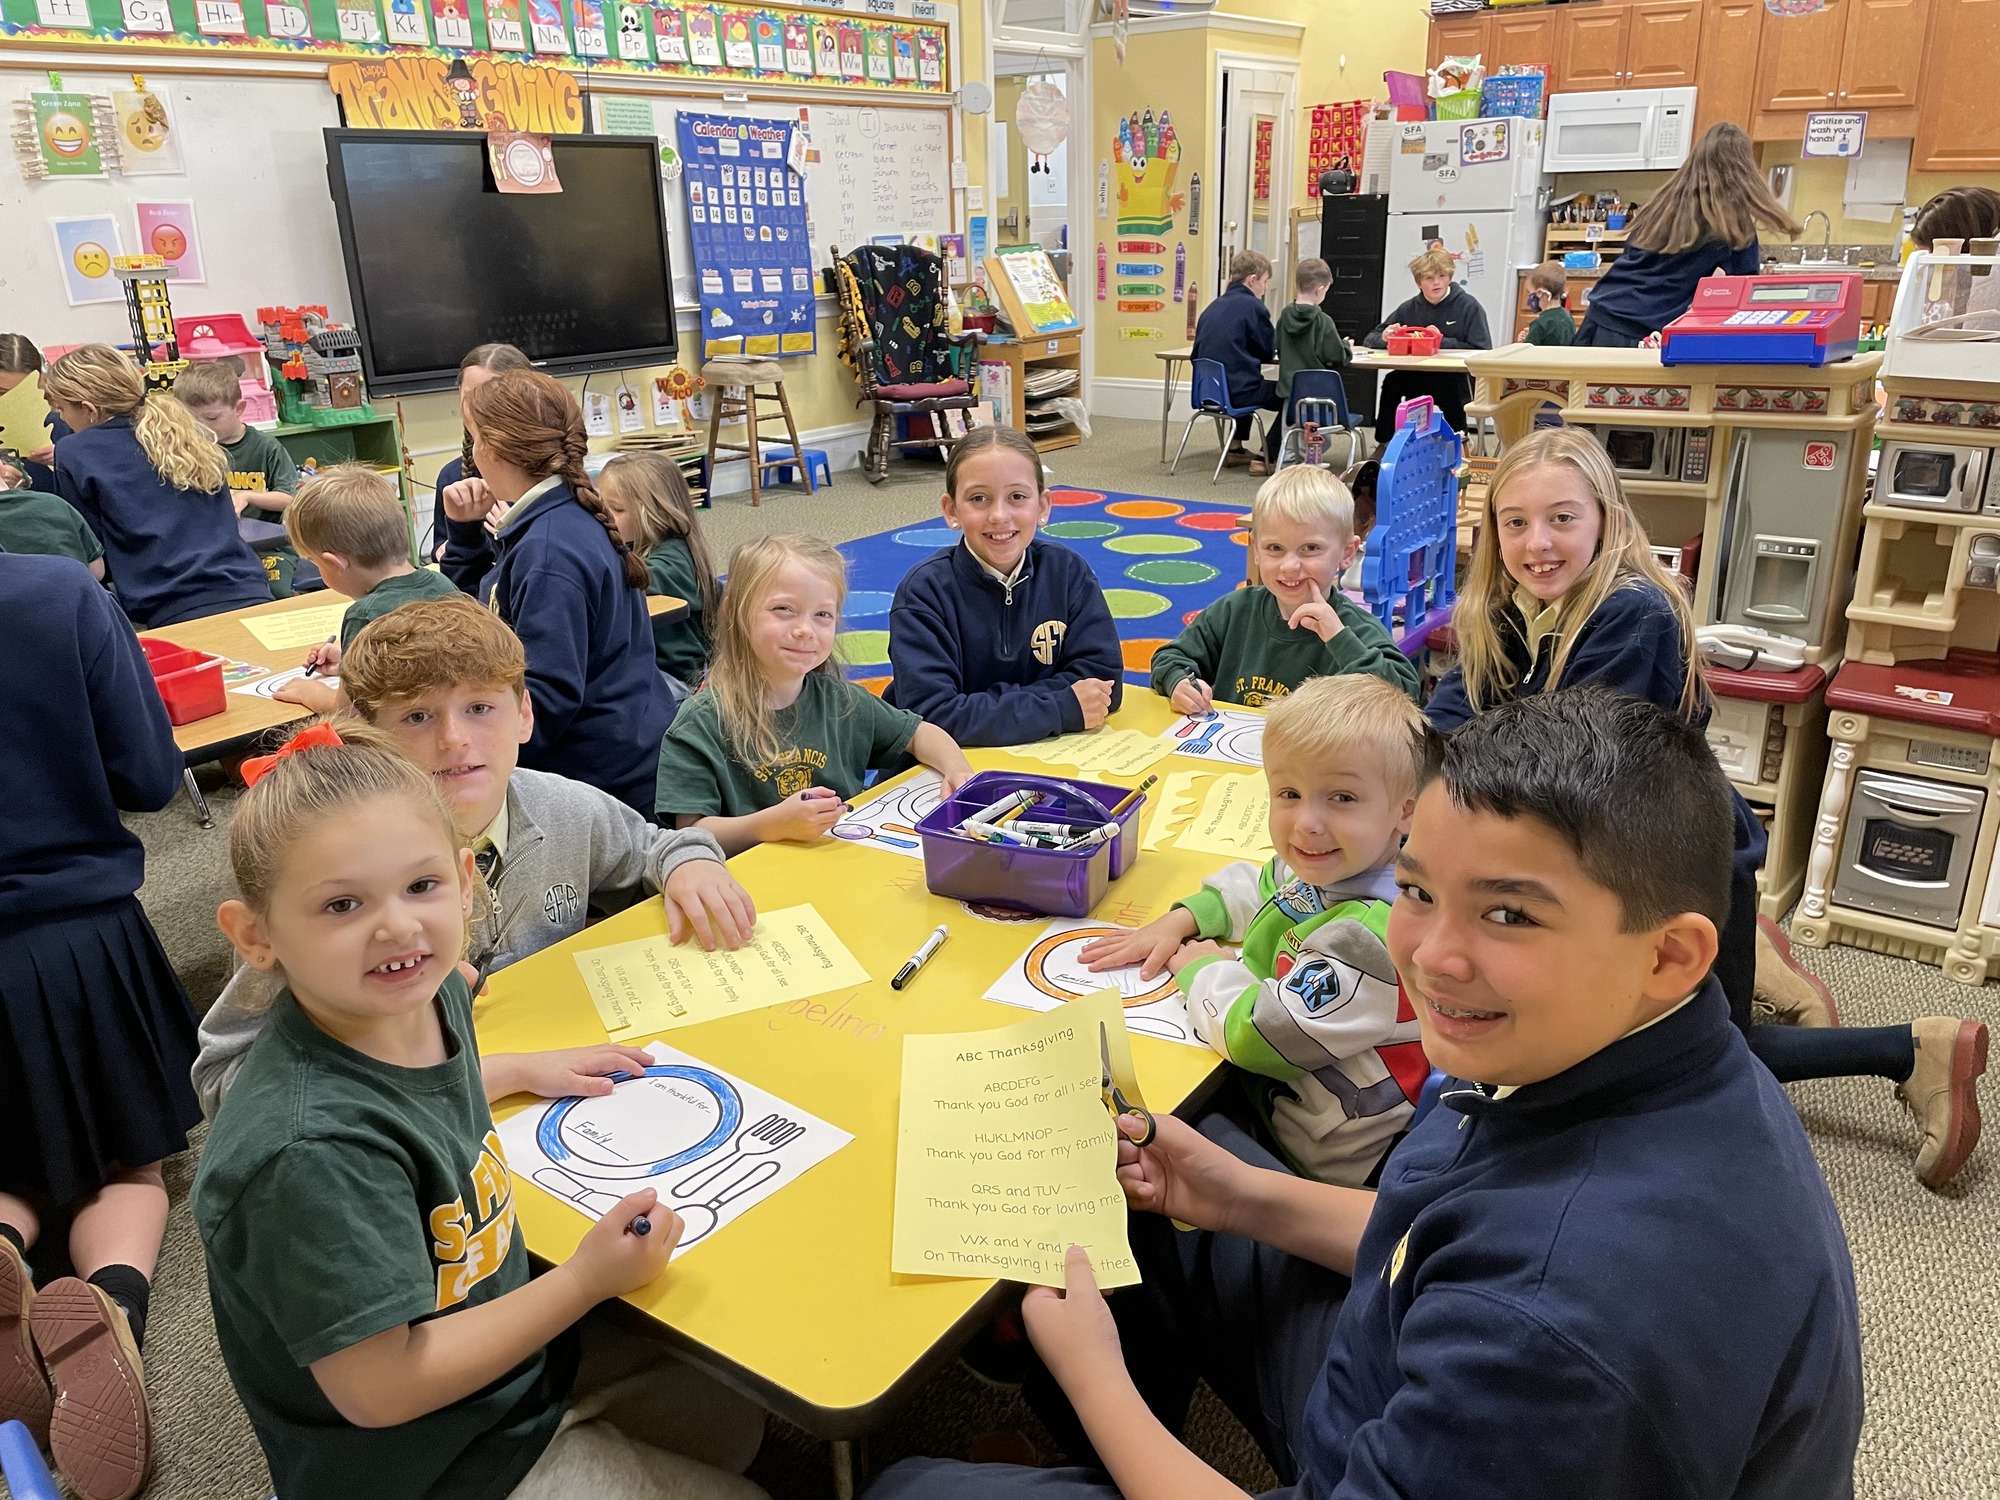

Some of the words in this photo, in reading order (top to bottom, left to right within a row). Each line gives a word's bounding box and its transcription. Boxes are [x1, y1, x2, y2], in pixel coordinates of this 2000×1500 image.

[867, 0, 894, 12] square
[915, 5, 935, 16] heart
[129, 1, 165, 30] Gg
[205, 3, 233, 24] Hh
[281, 7, 296, 28] Ii
[350, 12, 368, 40] Jj
[394, 15, 418, 34] Kk
[491, 23, 520, 42] Mm
[538, 27, 561, 45] Nn
[624, 33, 641, 56] Pp
[790, 49, 806, 67] Uu
[842, 55, 861, 71] Ww
[871, 56, 886, 73] Xx
[898, 57, 911, 76] Yy
[923, 60, 936, 76] Zz
[361, 64, 387, 78] happy
[41, 99, 61, 107] Green
[63, 99, 81, 107] Zone
[1811, 117, 1843, 125] Sanitize
[1844, 117, 1861, 125] and
[693, 121, 737, 139] Calendar
[749, 125, 786, 142] Weather
[1404, 126, 1422, 136] SFA
[1808, 135, 1835, 143] hands!
[1810, 126, 1831, 134] wash
[1833, 127, 1852, 135] your
[1438, 169, 1457, 178] SFA
[1099, 181, 1107, 204] white
[695, 208, 703, 219] 13
[711, 209, 719, 220] 14
[727, 209, 735, 220] 15
[743, 210, 752, 220] 16
[1132, 243, 1145, 251] red
[1130, 266, 1145, 274] blue
[1176, 261, 1184, 288] purple
[1129, 285, 1148, 294] green
[1127, 303, 1150, 312] orange
[1129, 329, 1150, 338] yellow
[1807, 446, 1832, 464] STEP
[1236, 677, 1249, 694] ST.
[1210, 781, 1238, 826] Thanksgiving
[544, 883, 579, 925] SFA
[803, 934, 834, 970] Thanksgiving
[956, 1051, 983, 1063] ABC
[988, 1026, 1075, 1060] Thanksgiving
[984, 1076, 1041, 1093] ABCDEFG
[654, 1082, 667, 1091] am
[666, 1087, 699, 1105] thankful
[933, 1099, 975, 1110] Thank
[977, 1099, 1001, 1114] you
[1004, 1097, 1029, 1109] God
[1033, 1092, 1050, 1104] for
[1054, 1085, 1069, 1099] all
[1071, 1083, 1076, 1092] I
[1079, 1074, 1100, 1090] see
[574, 1120, 614, 1144] Family
[974, 1127, 1054, 1144] HIJKLMNOP
[926, 1147, 966, 1159] Thank
[970, 1150, 993, 1165] you
[997, 1148, 1022, 1161] God
[1027, 1147, 1045, 1160] for
[1050, 1145, 1071, 1159] my
[1076, 1130, 1115, 1152] family
[971, 1183, 1001, 1195] QRS
[1005, 1186, 1031, 1197] and
[1033, 1184, 1062, 1197] TUV
[925, 1197, 969, 1210] Thank
[972, 1203, 997, 1216] you
[1001, 1203, 1027, 1215] God
[1032, 1205, 1051, 1216] for
[1056, 1200, 1096, 1215] loving
[1099, 1193, 1123, 1207] me
[960, 1234, 990, 1246] WX
[993, 1237, 1020, 1249] and
[1023, 1239, 1033, 1248] Y
[1037, 1242, 1062, 1254] and
[924, 1250, 945, 1261] On
[948, 1251, 1041, 1274] Thanksgiving
[1045, 1260, 1049, 1271] I
[1100, 1258, 1131, 1271] thee
